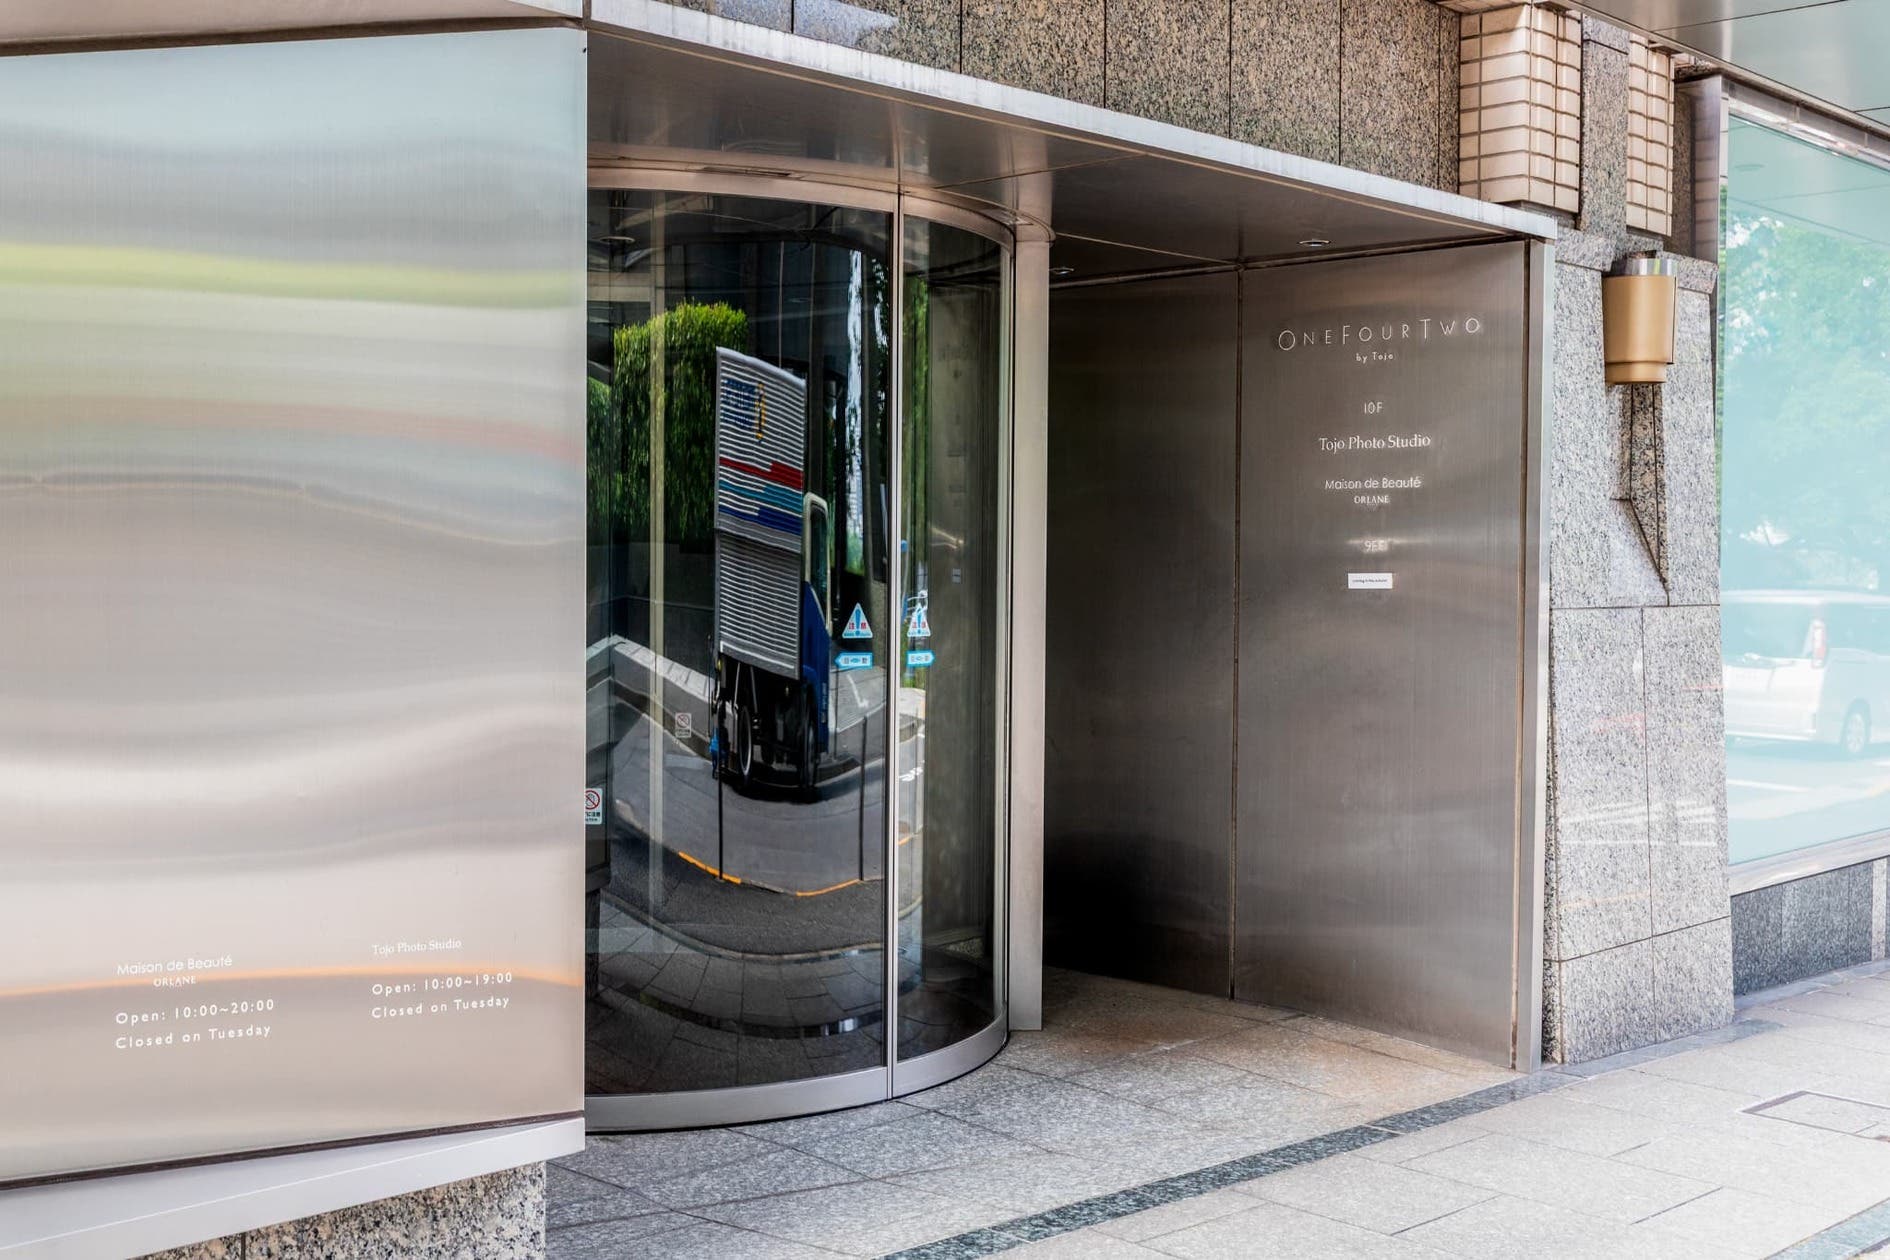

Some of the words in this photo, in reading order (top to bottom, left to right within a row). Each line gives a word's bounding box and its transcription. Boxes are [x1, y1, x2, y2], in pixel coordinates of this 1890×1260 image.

[1355, 352, 1368, 363] by
[1372, 351, 1394, 361] Tojo
[1319, 437, 1345, 454] Tojo
[1348, 435, 1385, 450] Photo
[1387, 433, 1431, 448] Studio
[1325, 478, 1362, 490] Maison
[1364, 477, 1379, 489] de
[1382, 475, 1422, 489] Beauté
[1353, 495, 1390, 504] ORLANE
[372, 944, 395, 957] Tojo
[397, 942, 427, 953] Photo
[429, 938, 462, 951] Studio
[116, 960, 163, 976] Maison
[167, 959, 184, 971] de
[187, 954, 233, 970] Beauté
[153, 975, 196, 987] ORLANE
[372, 983, 417, 997] Open:
[371, 1003, 423, 1018] Closed
[430, 1002, 448, 1013] on
[453, 996, 509, 1011] Tuesday
[115, 1011, 166, 1026] Open:
[115, 1033, 173, 1049] Closed
[182, 1032, 201, 1043] on
[208, 1024, 271, 1040] Tuesday
